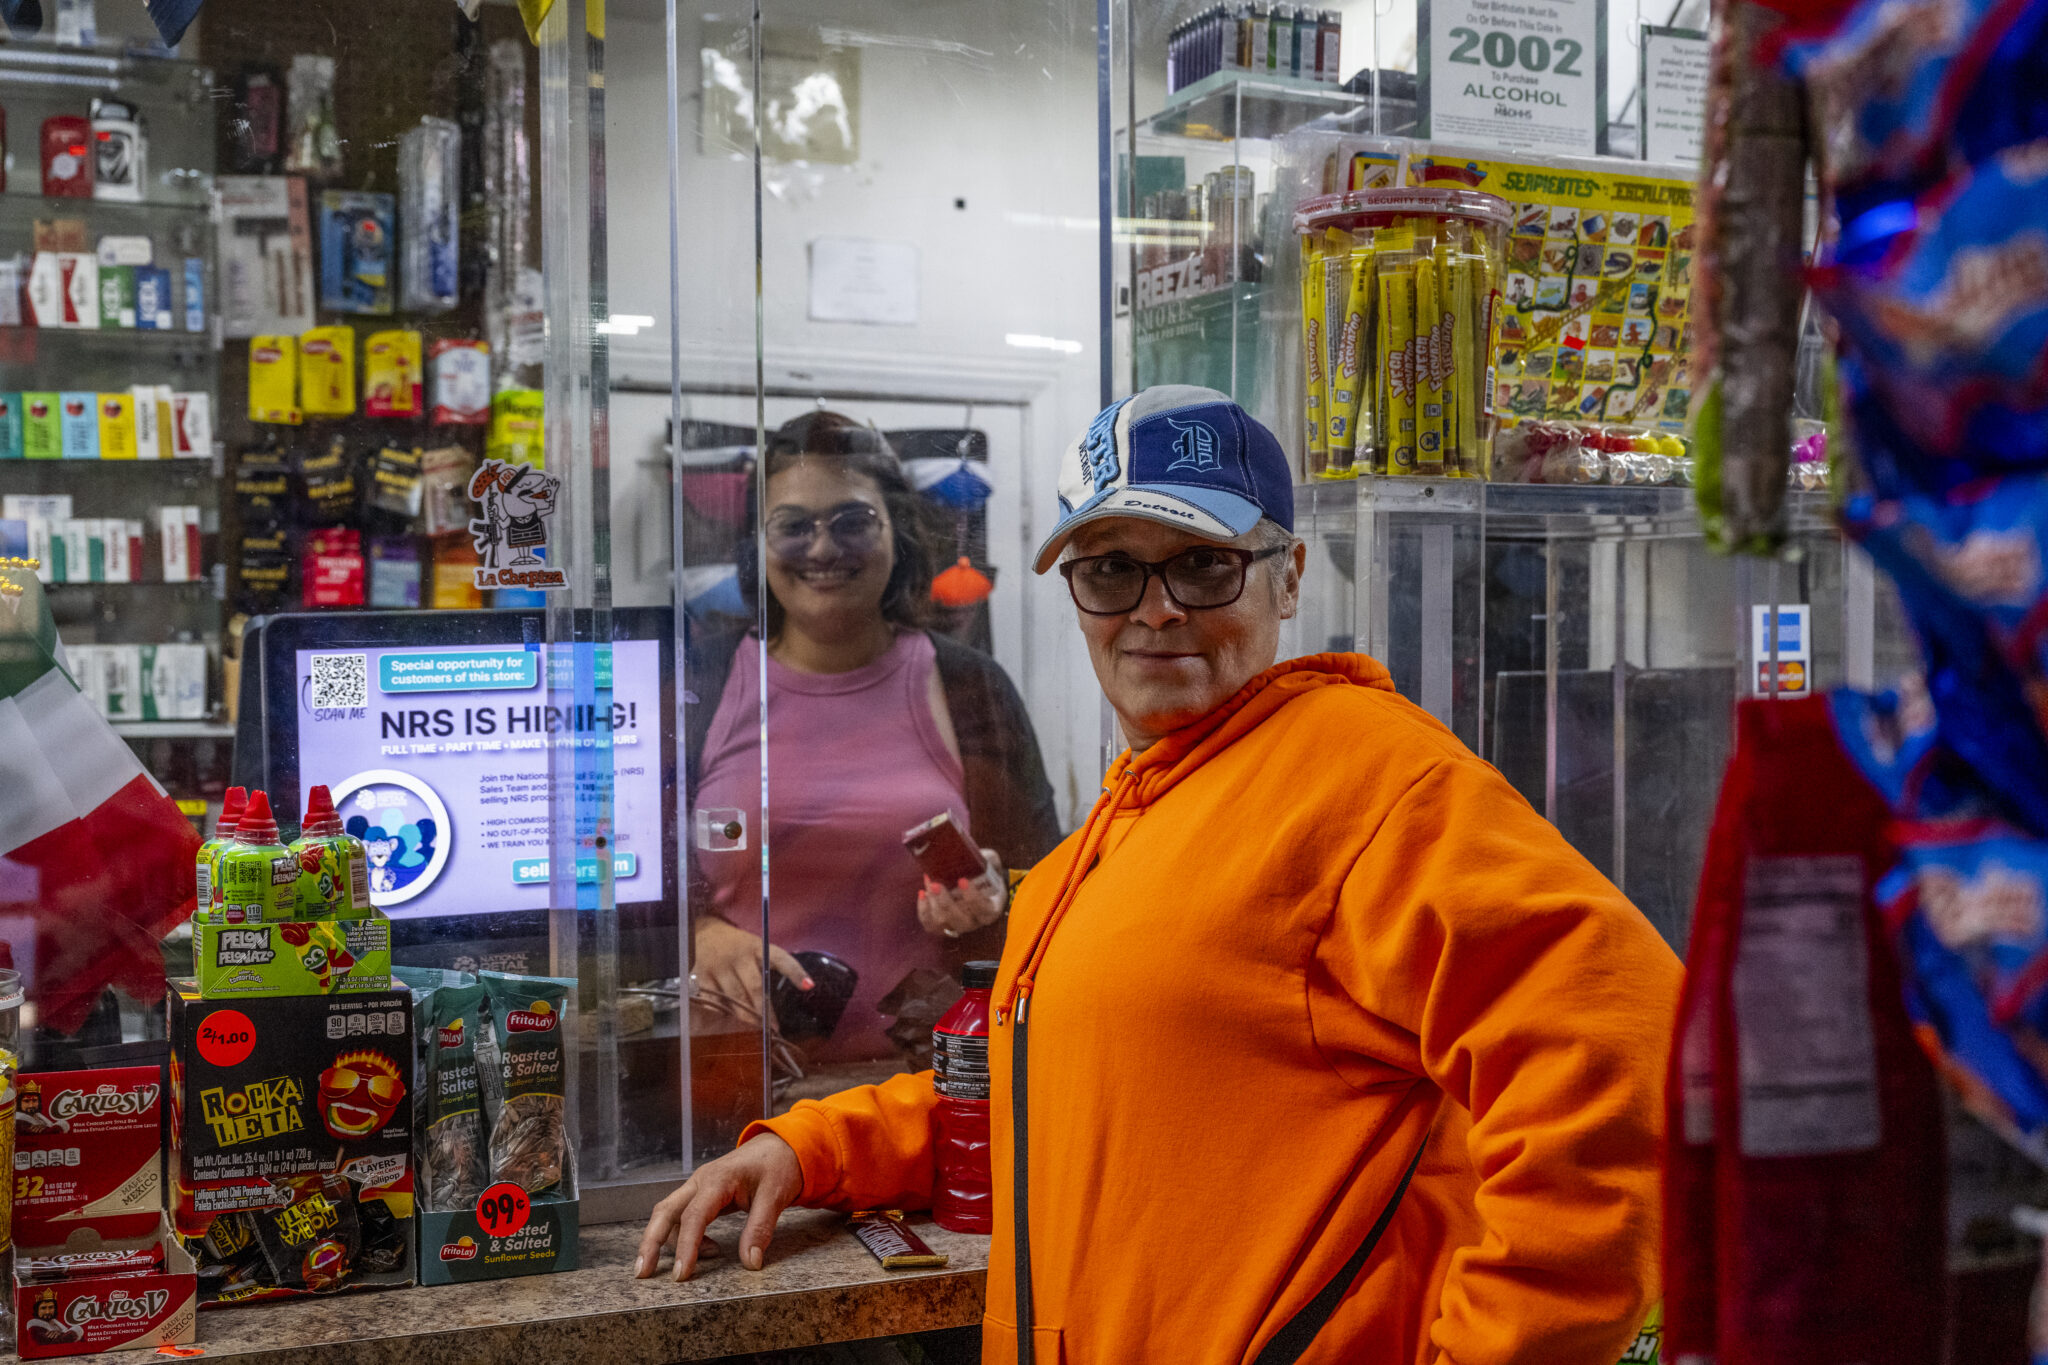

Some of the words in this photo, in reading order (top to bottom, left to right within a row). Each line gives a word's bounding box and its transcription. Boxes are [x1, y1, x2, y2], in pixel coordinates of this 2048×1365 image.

[1480, 15, 1489, 24] Or
[1491, 16, 1517, 28] Before
[1449, 27, 1583, 77] 2002
[1492, 71, 1501, 81] To
[1503, 72, 1538, 85] Purchase
[1463, 83, 1567, 107] ALCOHOL
[1504, 171, 1596, 198] SERPIENTES
[1367, 196, 1415, 205] SECURITY
[1418, 196, 1441, 205] SEAL
[1079, 440, 1093, 486] DETROIT
[1124, 500, 1196, 520] Detroit
[477, 570, 498, 586] La
[498, 568, 564, 588] Chapiza
[391, 660, 434, 673] Special
[436, 657, 504, 672] opportunity
[506, 657, 523, 668] for
[391, 673, 452, 685] customers
[455, 671, 467, 683] of
[469, 671, 491, 682] this
[493, 671, 525, 682] store:
[314, 708, 345, 721] SCAN
[349, 707, 368, 720] ME
[381, 708, 454, 739] NRS
[465, 707, 497, 735] IS
[381, 745, 409, 756] FULL
[410, 743, 437, 754] TIME
[445, 741, 473, 753] PART
[475, 740, 502, 751] TIME
[510, 739, 541, 749] MAKE
[480, 774, 498, 783] Join
[500, 773, 515, 782] the
[621, 767, 645, 776] (NRS)
[480, 785, 503, 794] Sales
[506, 784, 529, 793] Team
[531, 783, 547, 791] and
[480, 795, 508, 805] selling
[510, 794, 528, 802] NRS
[502, 840, 526, 848] TRAIN
[527, 839, 544, 847] YOU
[221, 929, 270, 950] PELON
[341, 1002, 363, 1010] SERVING
[331, 1017, 342, 1028] 90
[203, 1027, 249, 1045] 2/1.00
[502, 1048, 558, 1064] Roasted
[503, 1065, 513, 1078] &
[516, 1061, 560, 1076] Salted
[504, 1079, 535, 1088] Sunflower
[200, 1076, 304, 1124] ROCKA
[86, 1119, 113, 1127] CHOCOLATE
[213, 1105, 305, 1147] LETA
[194, 1156, 203, 1167] Net
[245, 1152, 258, 1164] 25.4
[296, 1148, 307, 1159] 720
[308, 1150, 312, 1160] g
[194, 1168, 220, 1180] Contents/
[221, 1166, 245, 1178] Contiene
[246, 1165, 254, 1176] 30
[260, 1163, 272, 1175] 0.84
[319, 1160, 336, 1171] piezas
[360, 1158, 397, 1174] LAYERS
[385, 1164, 404, 1174] Center
[15, 1175, 45, 1199] 32
[371, 1172, 400, 1186] lollipop
[122, 1173, 158, 1206] MEXICO
[195, 1188, 215, 1201] Lollipop
[217, 1187, 229, 1198] with
[230, 1185, 241, 1197] Chili
[242, 1184, 263, 1196] Powder
[195, 1200, 212, 1212] Paleta
[213, 1198, 238, 1210] Enchilada
[239, 1199, 249, 1208] con
[249, 1196, 266, 1207] Centro
[482, 1193, 525, 1230] 99¢
[490, 1240, 501, 1252] &
[504, 1234, 552, 1252] Salted
[484, 1254, 527, 1264] Sunflower
[530, 1250, 556, 1259] Seeds
[100, 1321, 126, 1329] CHOCOLATE
[162, 1312, 194, 1343] MEXICO
